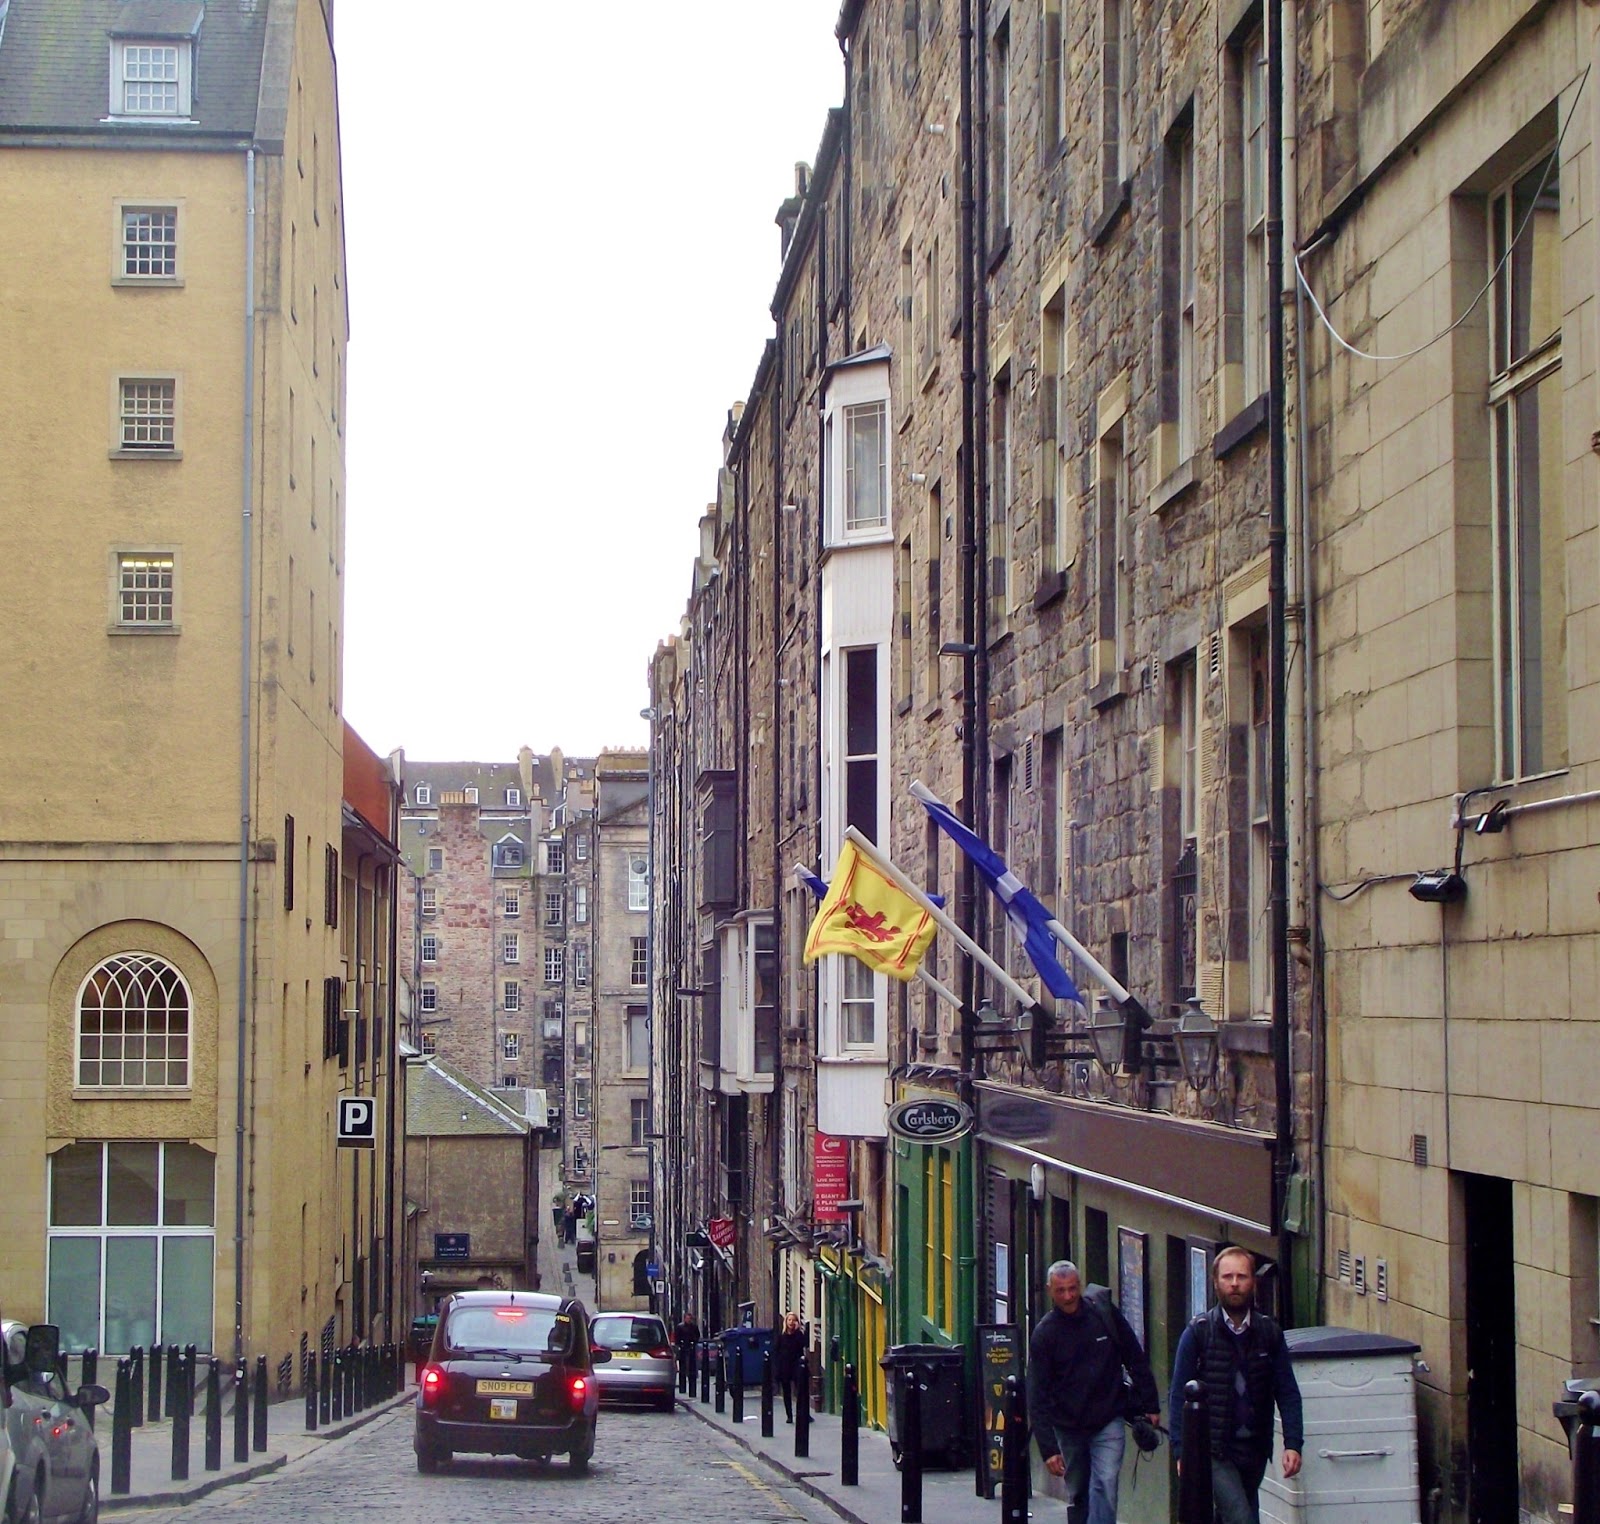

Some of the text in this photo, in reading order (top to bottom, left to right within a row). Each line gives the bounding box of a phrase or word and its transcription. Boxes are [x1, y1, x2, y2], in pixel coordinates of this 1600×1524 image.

[345, 1102, 368, 1133] P
[904, 1108, 956, 1129] Carlsberg
[481, 1381, 528, 1392] SN09 FCZ
